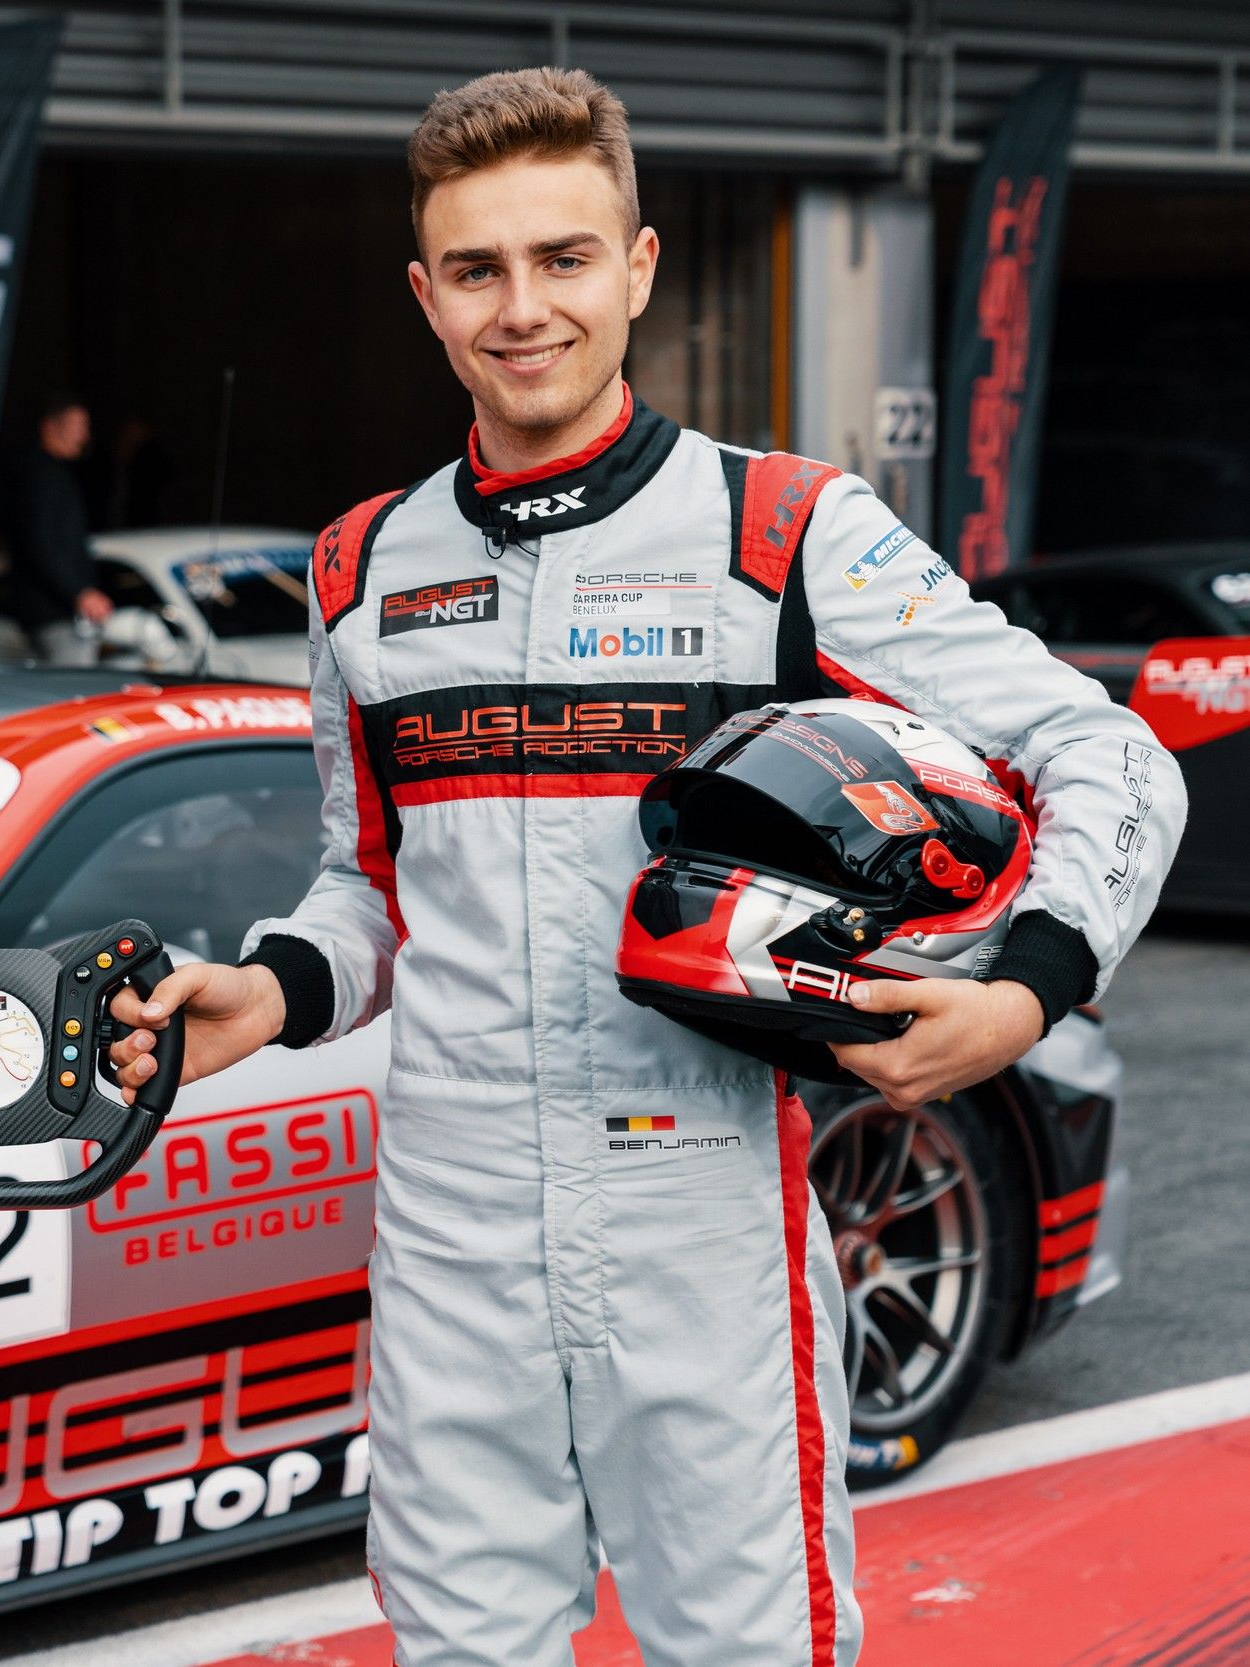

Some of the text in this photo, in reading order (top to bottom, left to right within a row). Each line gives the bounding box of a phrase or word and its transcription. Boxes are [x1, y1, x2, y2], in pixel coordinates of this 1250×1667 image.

[888, 402, 932, 448] 22
[764, 462, 824, 549] HRX
[575, 572, 698, 585] PORSCHE
[384, 580, 494, 610] AUGUST
[429, 594, 494, 624] NGT
[572, 605, 617, 615] BENELUX
[573, 592, 643, 604] CARRERA CUP
[569, 627, 692, 658] Mobil 1
[394, 702, 686, 744] AUGUST
[396, 740, 686, 767] PORSCHE ADDICTION
[608, 1136, 741, 1150] BENJAMIN
[123, 1196, 345, 1267] BELGIQUE
[145, 1451, 322, 1545] TOP
